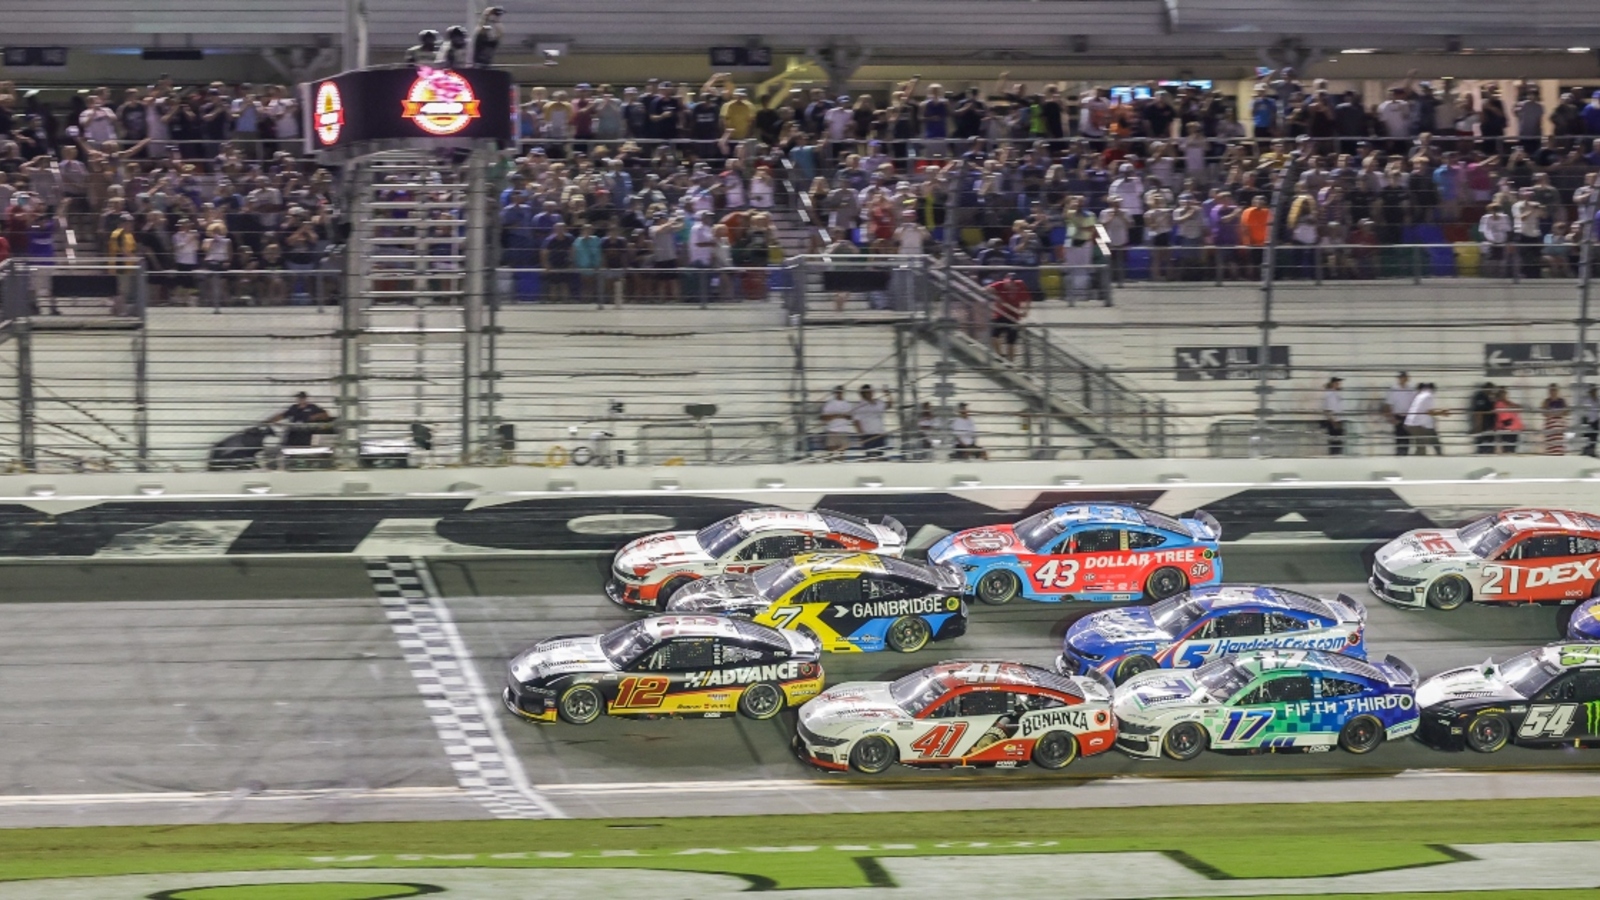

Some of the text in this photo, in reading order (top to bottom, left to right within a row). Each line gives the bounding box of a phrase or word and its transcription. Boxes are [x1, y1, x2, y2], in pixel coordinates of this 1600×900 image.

[807, 553, 861, 573] 7
[1084, 549, 1195, 569] DOLLAR TREE
[1192, 563, 1210, 577] STP
[1034, 559, 1080, 589] 43
[1480, 564, 1520, 595] 21
[852, 596, 942, 618] GAINBRIDGE
[1211, 587, 1258, 608] 5
[771, 606, 803, 629] 7
[1178, 643, 1215, 668] 5
[707, 663, 798, 686] ADVANCE
[953, 663, 1001, 684] 41
[613, 676, 670, 710] 12
[1285, 702, 1337, 717] FIFTH
[1517, 702, 1579, 739] 54
[1022, 711, 1089, 737] BONANZA
[1215, 707, 1276, 744] 17
[910, 720, 970, 758] 41
